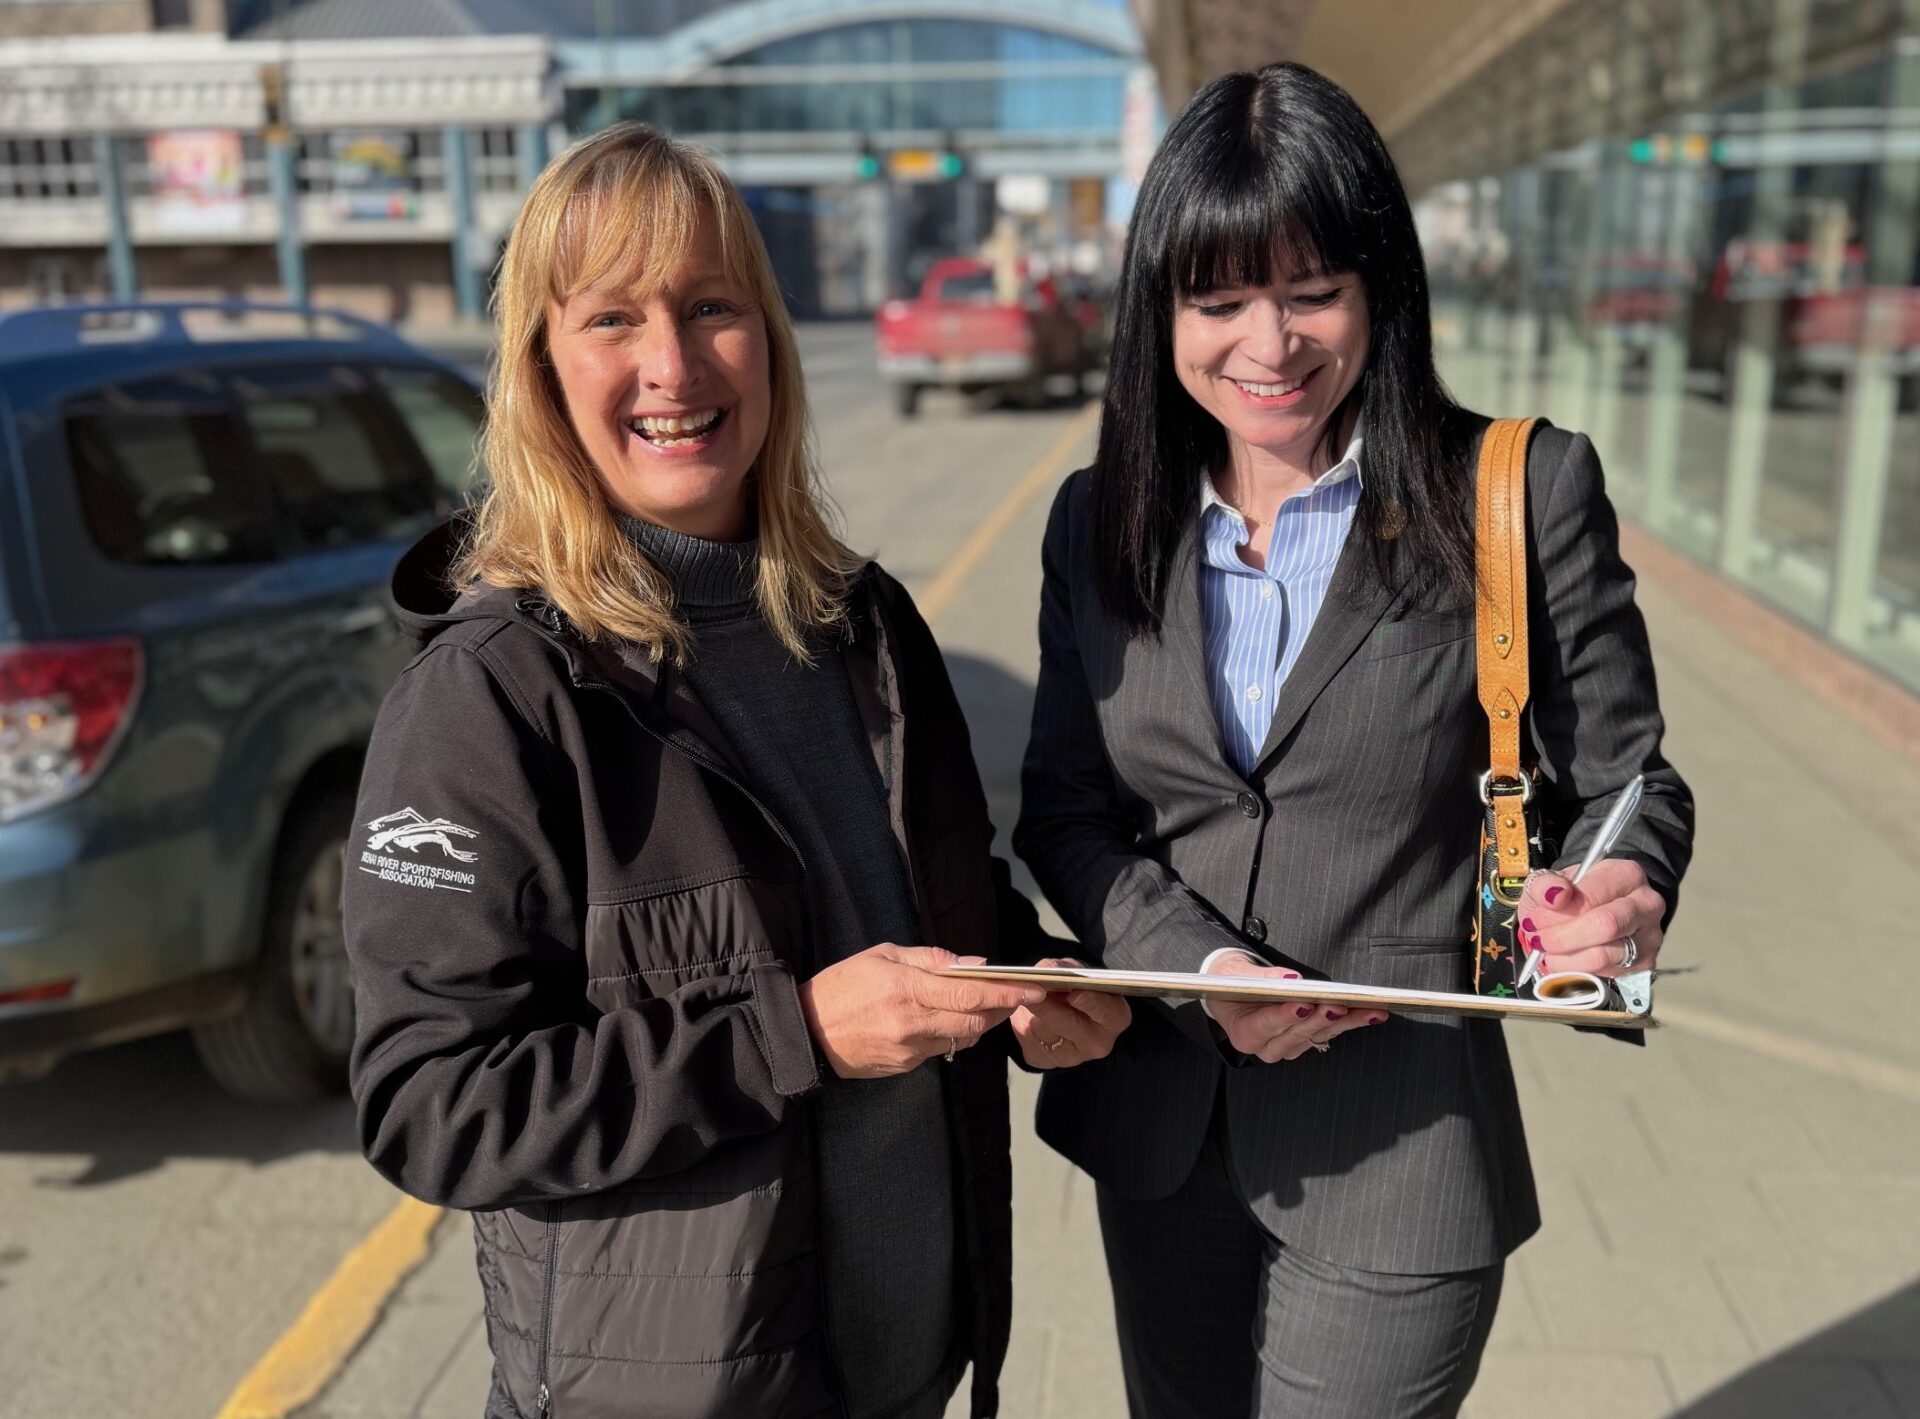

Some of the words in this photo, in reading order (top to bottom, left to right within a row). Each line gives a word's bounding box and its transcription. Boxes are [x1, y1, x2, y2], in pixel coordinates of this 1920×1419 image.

[377, 856, 399, 870] RIVER
[400, 861, 475, 885] SPORTSFISHING
[379, 869, 435, 889] ASSOCIATION
